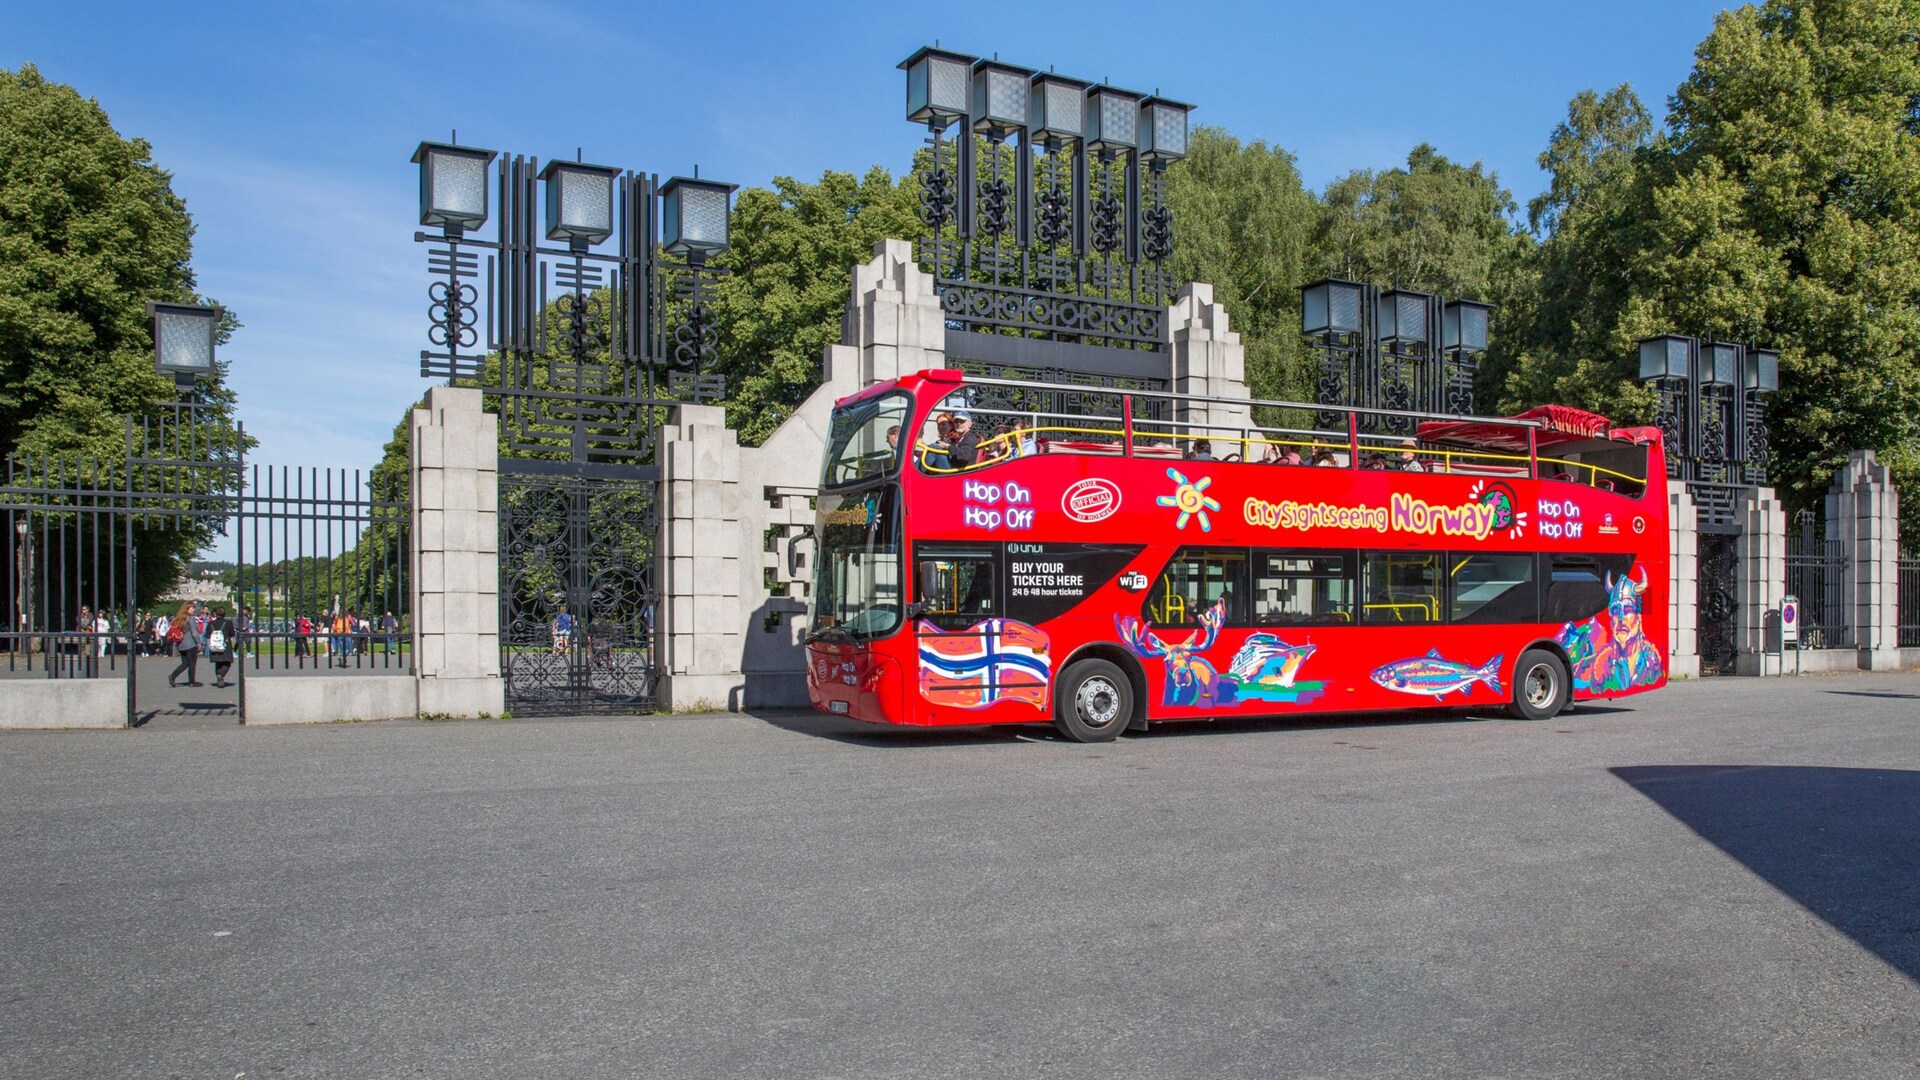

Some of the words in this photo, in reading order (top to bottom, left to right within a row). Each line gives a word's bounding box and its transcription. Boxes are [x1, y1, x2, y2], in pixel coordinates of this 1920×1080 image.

[964, 480, 1001, 504] Hop
[1005, 481, 1030, 503] On
[1078, 480, 1097, 490] TOUR
[1073, 492, 1110, 508] OFFICIAL
[1088, 506, 1113, 521] NORWAY
[1391, 492, 1495, 540] Norway
[1538, 500, 1562, 518] Hop
[1564, 500, 1581, 518] On
[964, 506, 1002, 530] Hop
[1005, 507, 1034, 529] Off
[1539, 521, 1563, 539] Hop
[1565, 520, 1584, 538] Off
[1012, 562, 1034, 574] BUY
[1035, 562, 1064, 574] YOUR
[1012, 575, 1055, 586] TICKETS
[1057, 575, 1083, 586] HERE
[1012, 588, 1022, 596] 24
[1023, 588, 1030, 596] &
[1031, 588, 1040, 596] 48
[1041, 588, 1058, 596] hour
[1059, 588, 1083, 596] tickets
